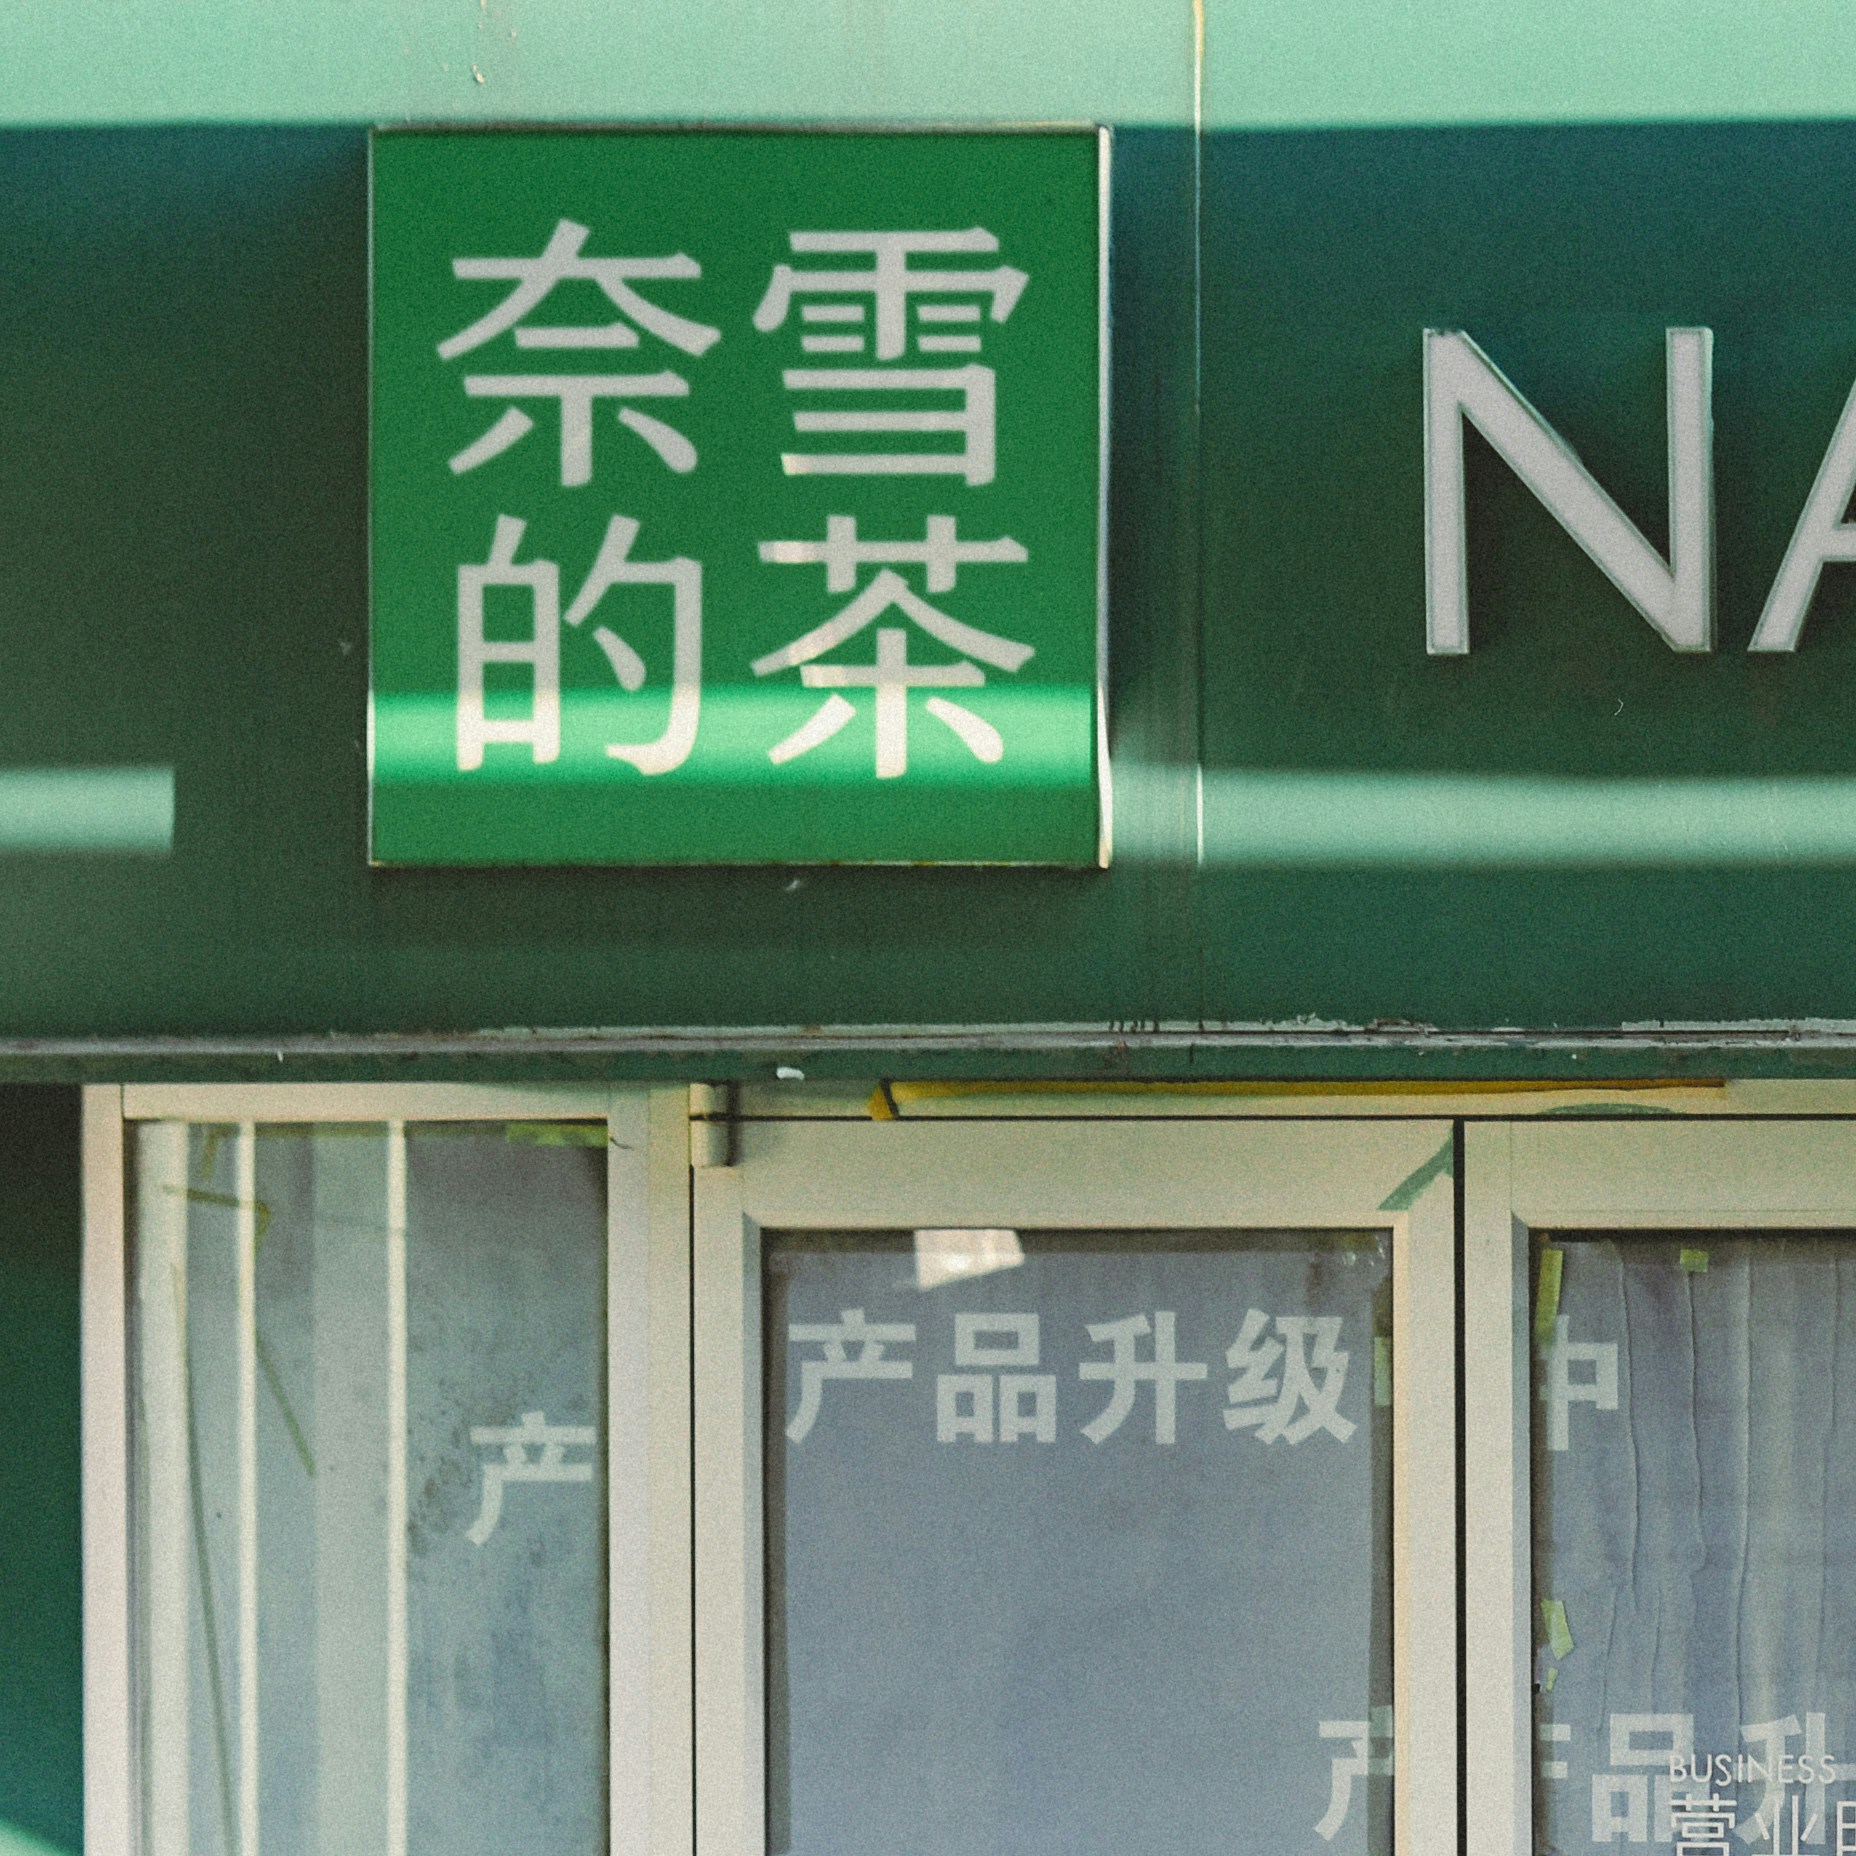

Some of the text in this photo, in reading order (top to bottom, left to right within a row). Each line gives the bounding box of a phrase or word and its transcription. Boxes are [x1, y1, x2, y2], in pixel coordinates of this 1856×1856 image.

[436, 218, 1030, 487] 奈雪
[455, 514, 1036, 779] 的茶
[465, 1411, 597, 1547] 产
[1669, 1754, 1836, 1787] BUSINESS
